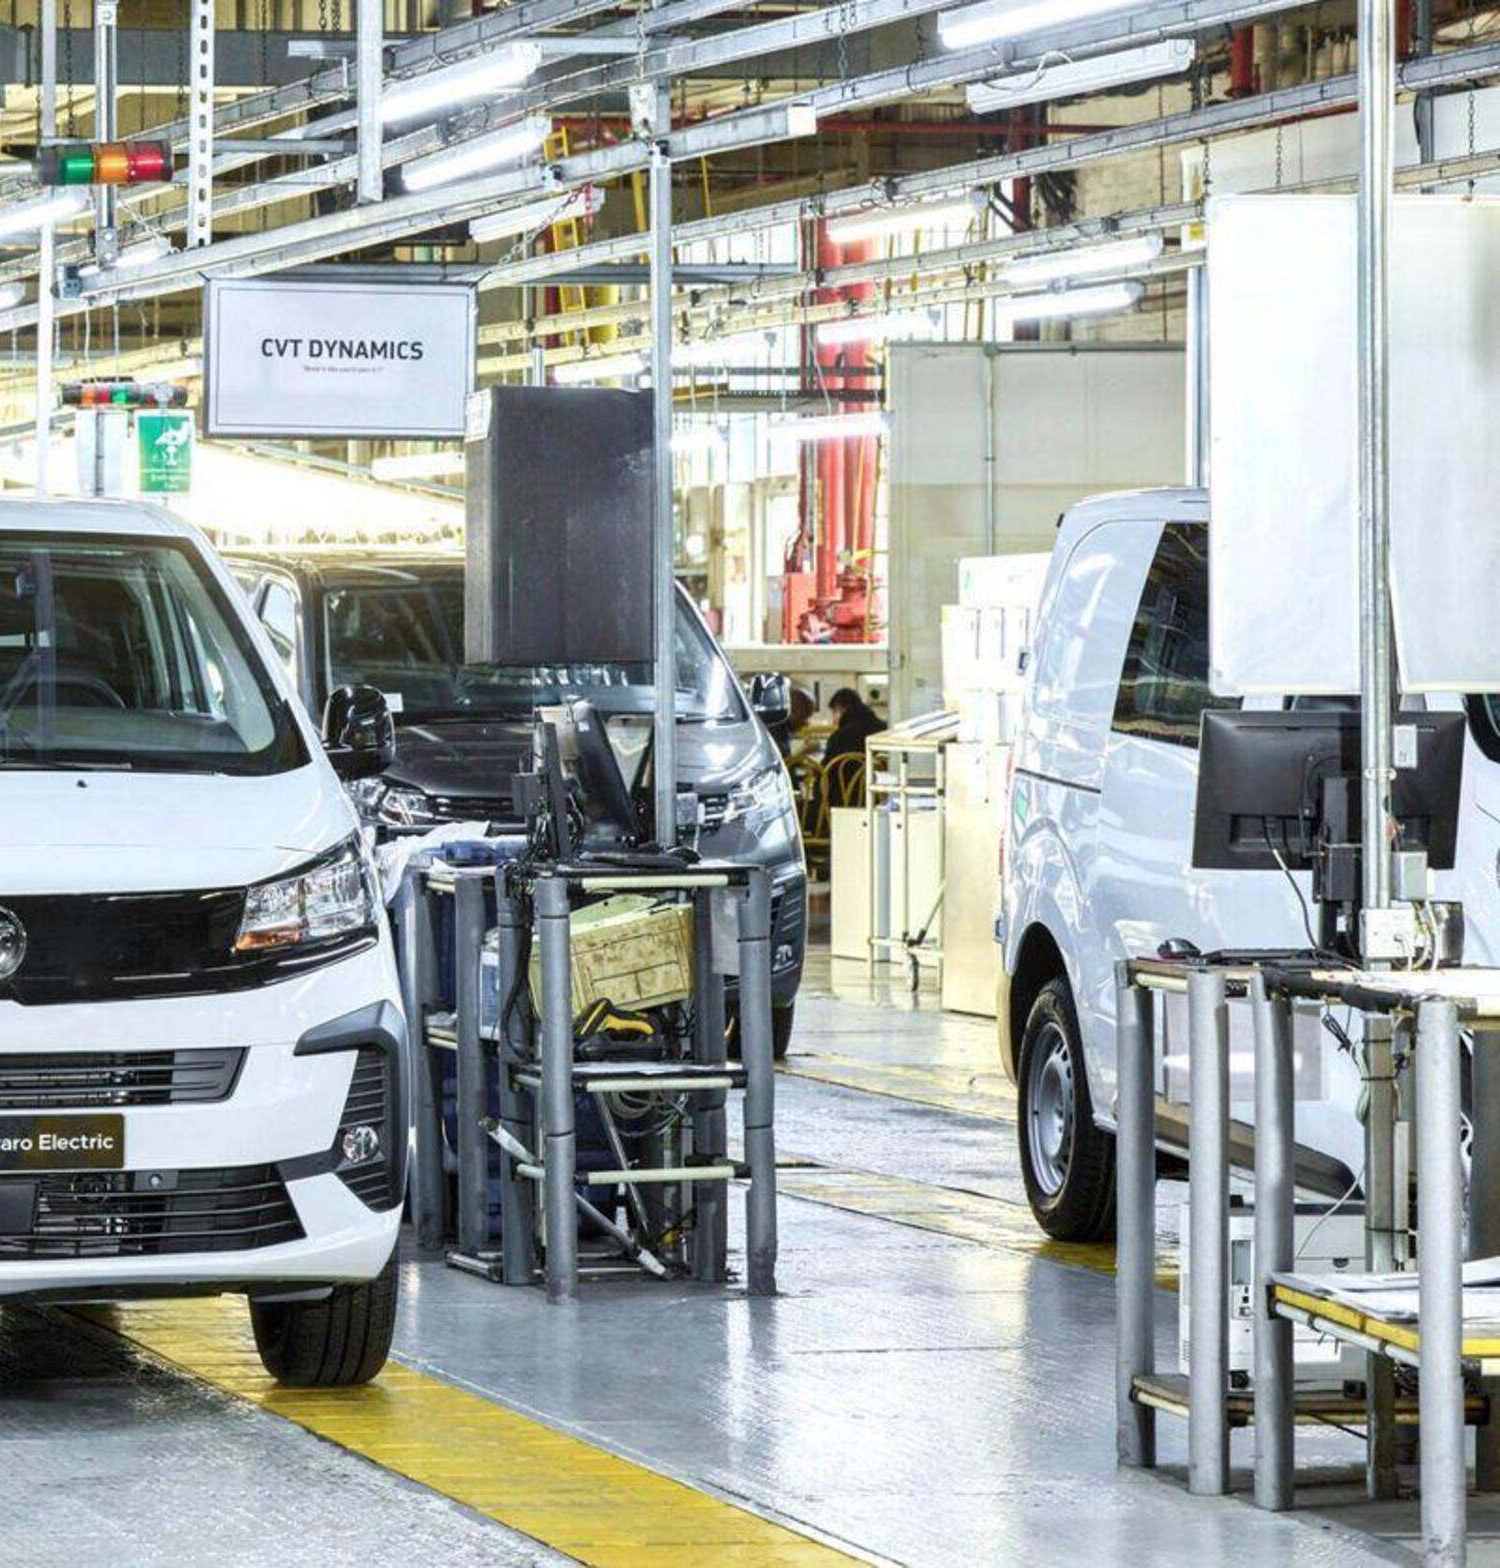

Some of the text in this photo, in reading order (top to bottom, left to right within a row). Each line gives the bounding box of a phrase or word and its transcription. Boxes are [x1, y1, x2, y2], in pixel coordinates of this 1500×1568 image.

[261, 338, 424, 361] CVT DYNAMICS
[38, 1132, 114, 1151] Electric
